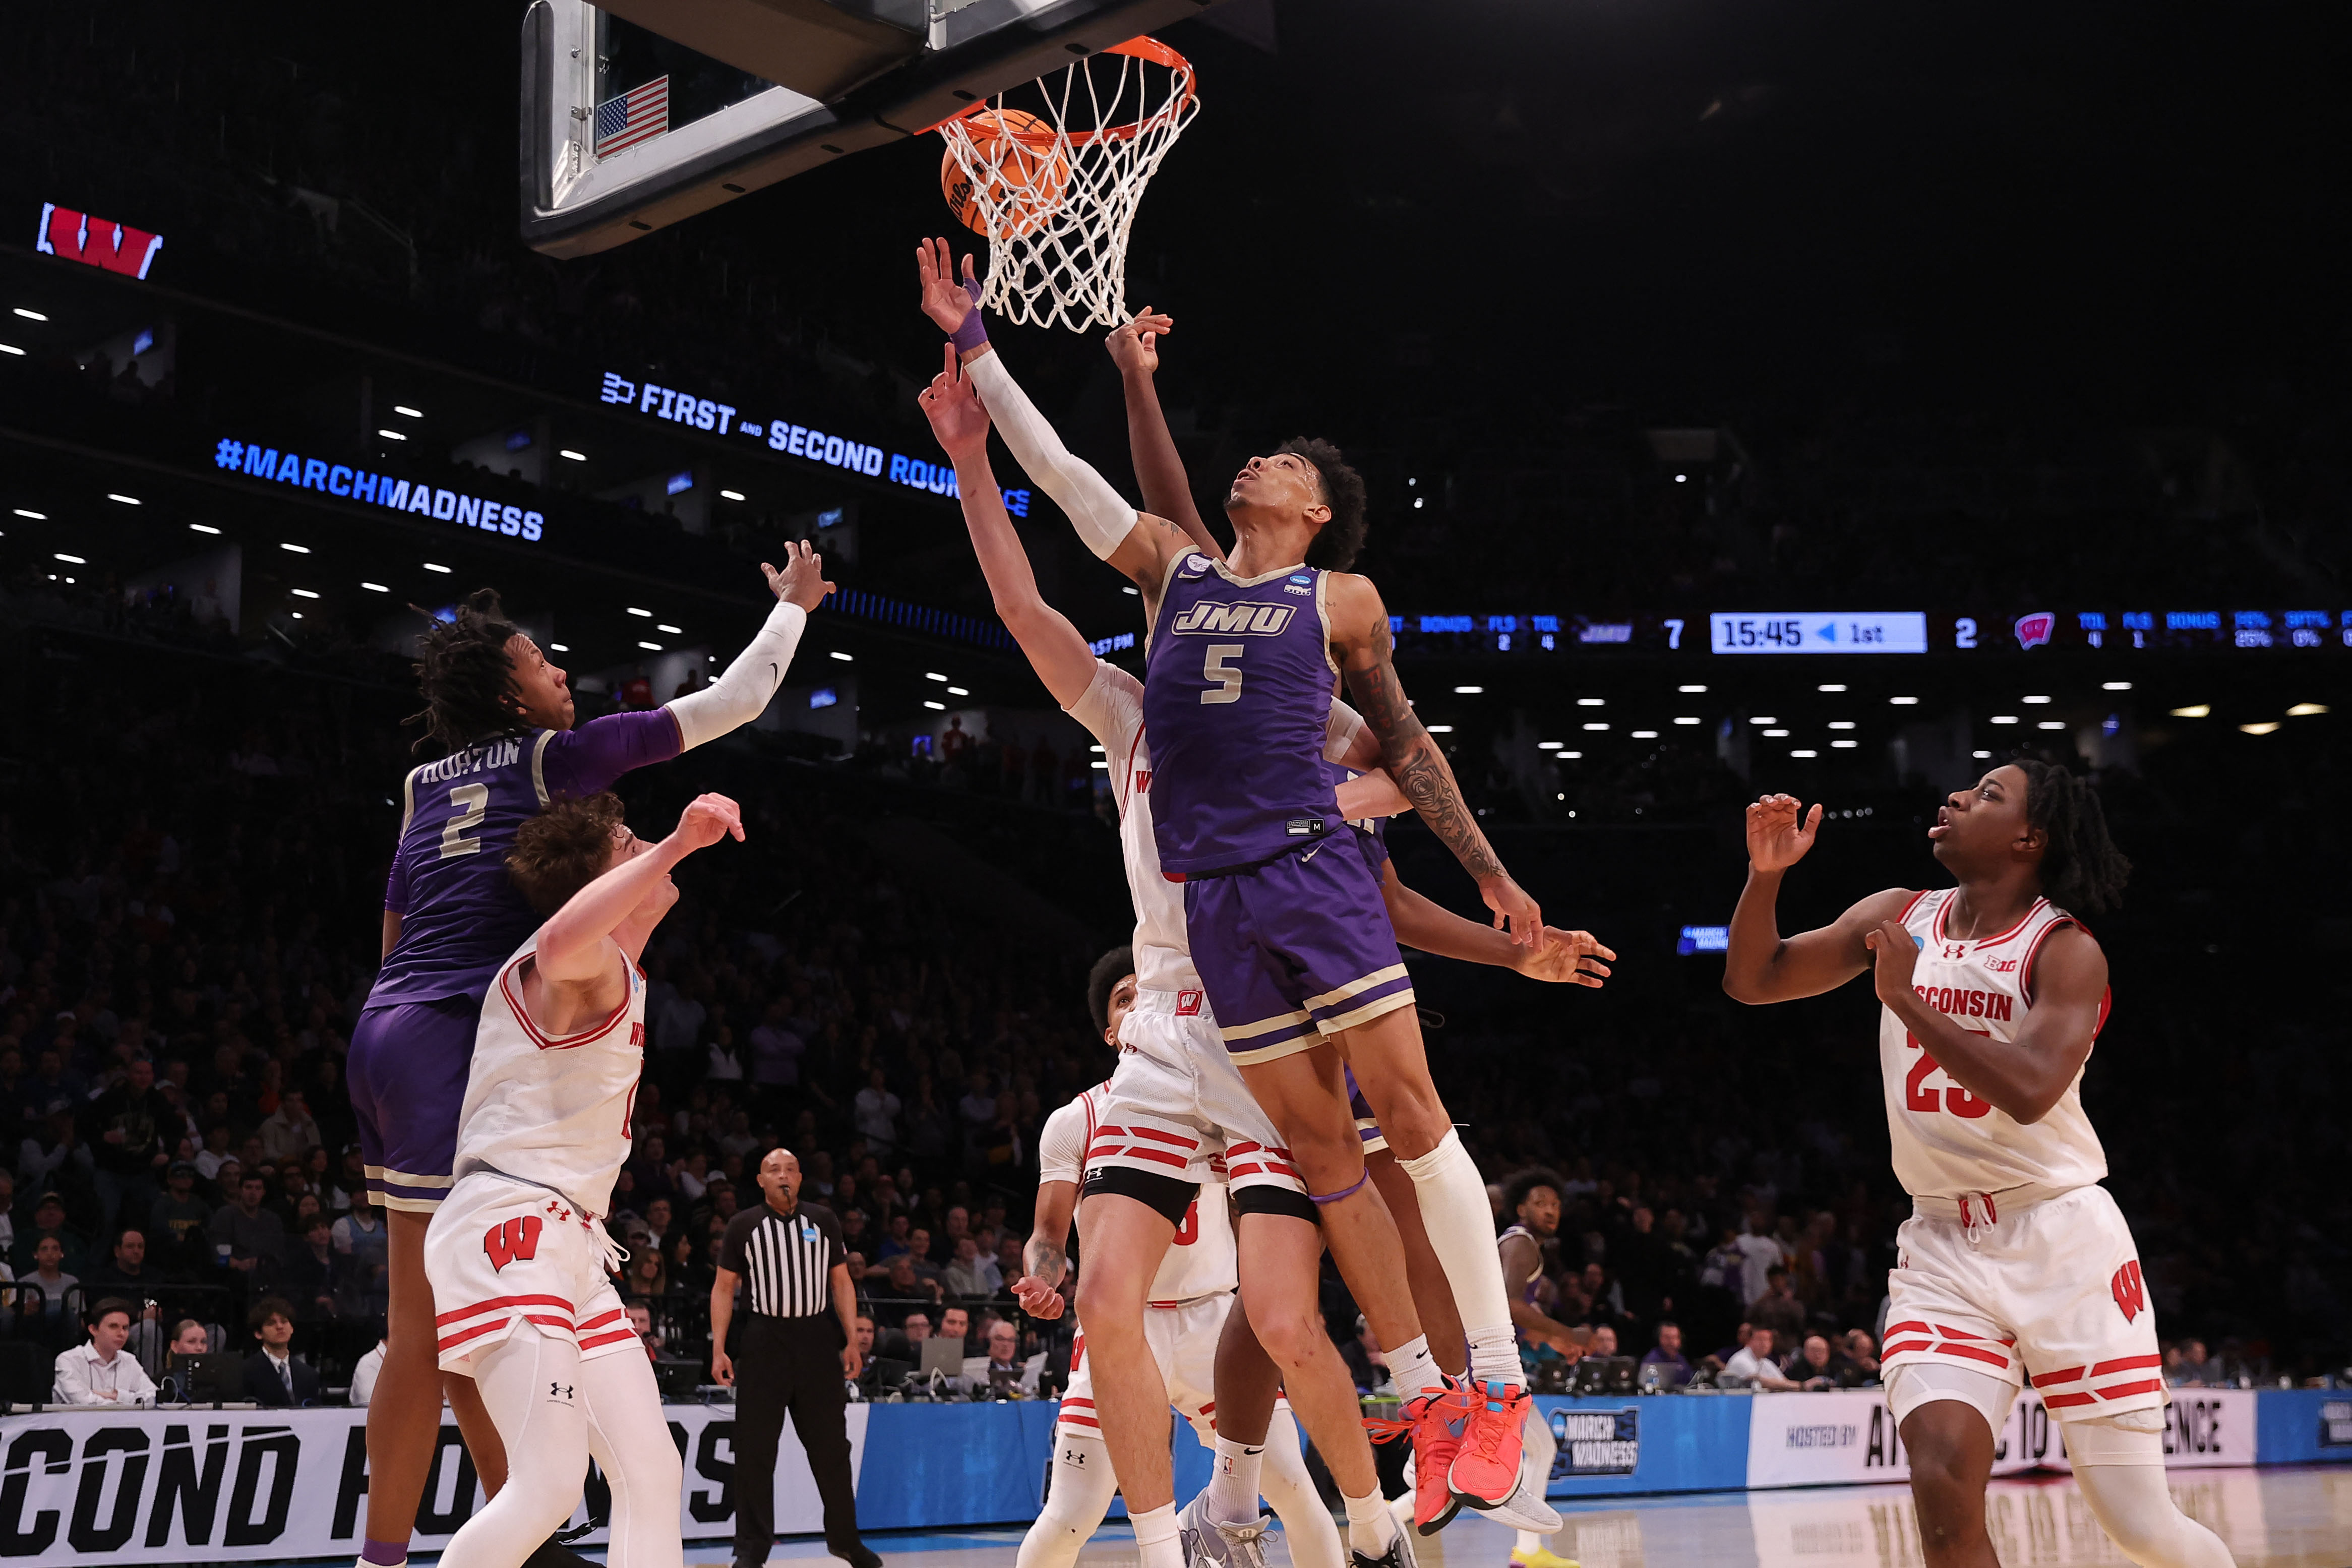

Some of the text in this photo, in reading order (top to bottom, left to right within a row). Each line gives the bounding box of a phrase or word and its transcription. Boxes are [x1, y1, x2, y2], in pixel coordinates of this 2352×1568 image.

[640, 383, 961, 499] FIRST AND SECOND ROUN
[215, 438, 544, 541] #MARCHMADNESS
[1174, 602, 1293, 634] JMU
[1664, 617, 1977, 649] 7 15:45 1st 2
[1200, 644, 1244, 704] 5
[439, 782, 489, 859] 2
[1912, 985, 2012, 1021] SCONSIN
[484, 1215, 543, 1274] W
[2112, 1260, 2144, 1325] W
[1787, 1425, 1836, 1448] HOSTED
[0, 1424, 301, 1557] COND
